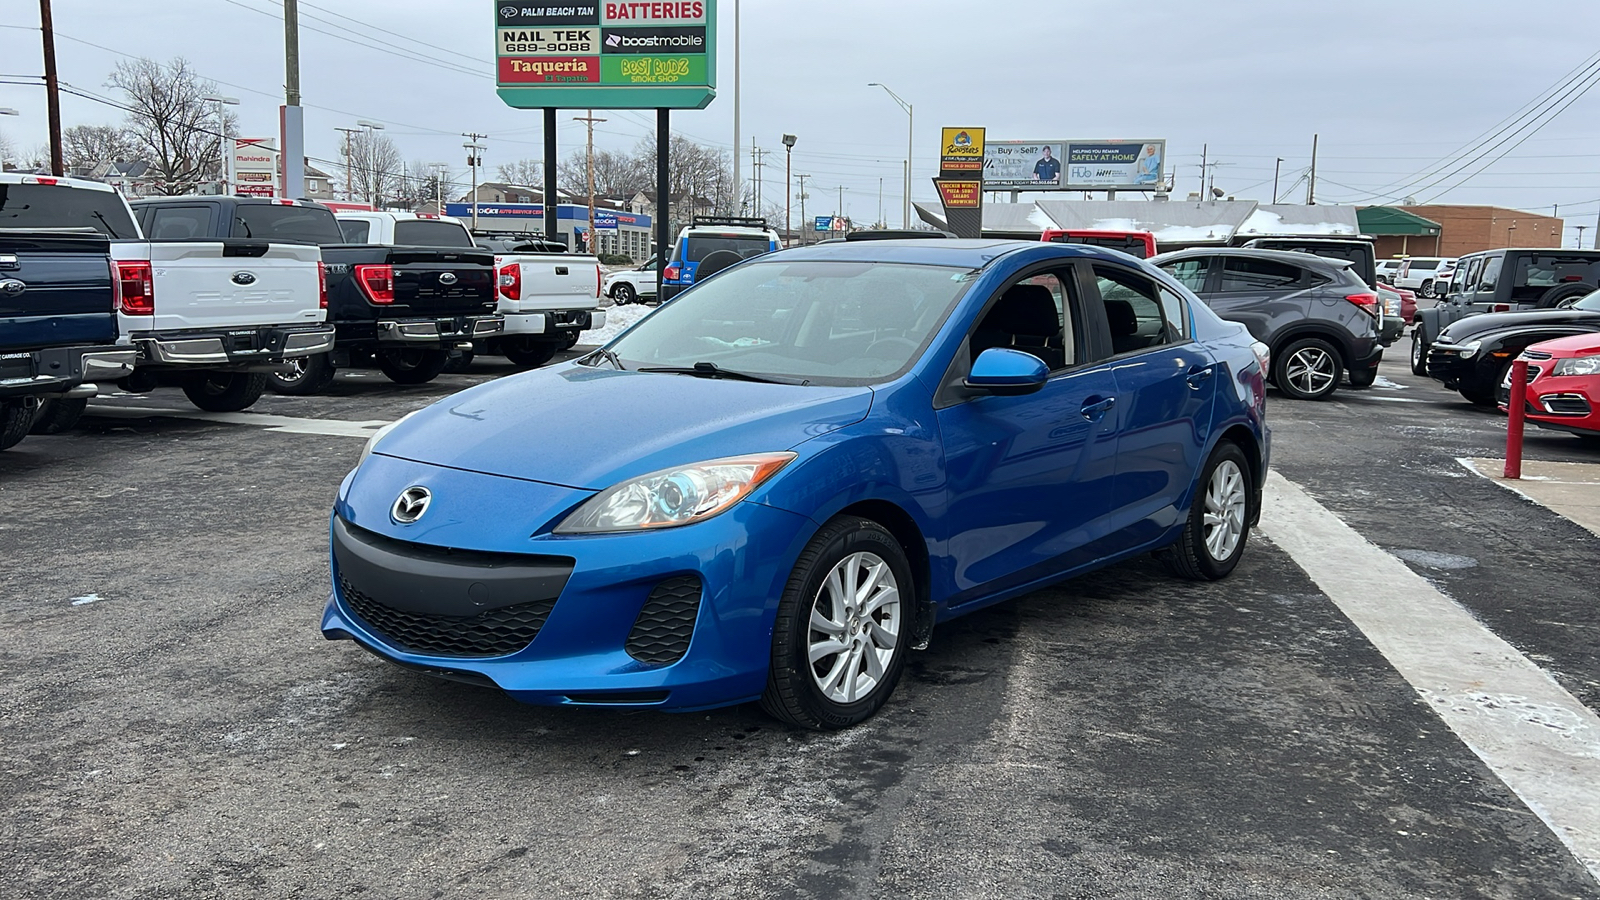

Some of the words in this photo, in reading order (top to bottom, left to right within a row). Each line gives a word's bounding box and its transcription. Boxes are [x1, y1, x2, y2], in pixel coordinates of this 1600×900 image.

[521, 7, 545, 16] PALM
[546, 7, 575, 16] BEACH
[577, 6, 594, 16] TAN
[606, 2, 703, 20] BATTERIES
[504, 31, 545, 42] NAIL
[552, 30, 592, 42] TEK
[506, 43, 590, 52] 689-9088
